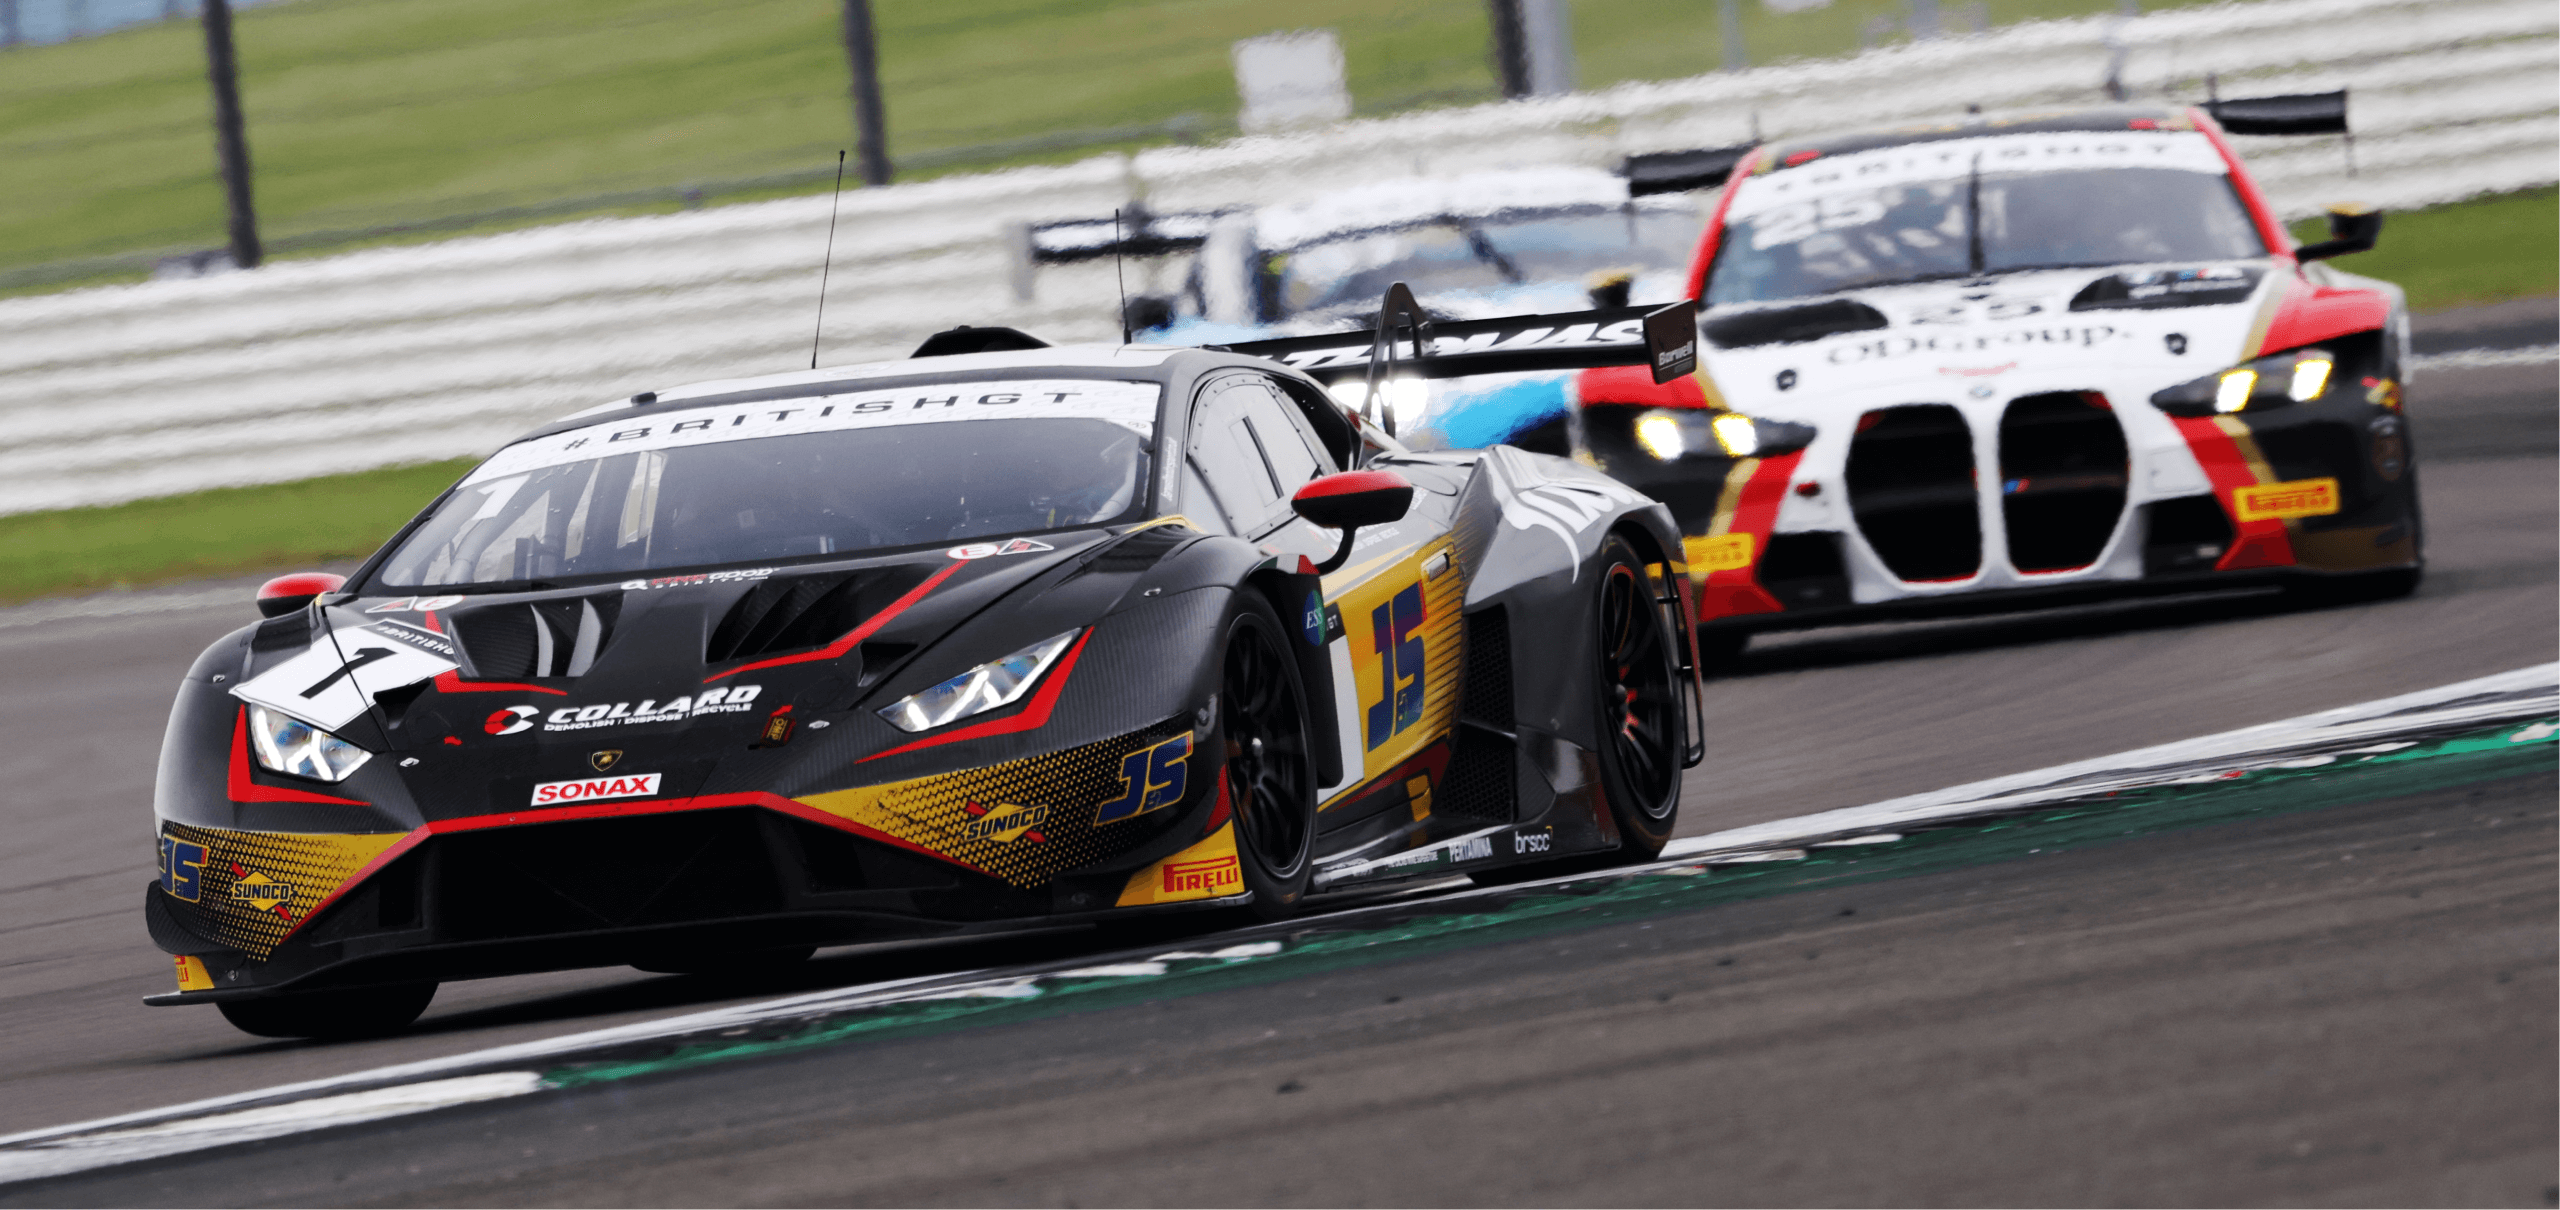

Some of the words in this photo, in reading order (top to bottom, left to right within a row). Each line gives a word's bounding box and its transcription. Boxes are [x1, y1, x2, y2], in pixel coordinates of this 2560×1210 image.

[563, 391, 1091, 451] #BRITISHGT
[376, 625, 456, 655] #BRITISHG
[298, 647, 399, 700] 1
[1366, 579, 1428, 753] JS
[543, 718, 615, 732] DEMOLISH
[624, 713, 683, 725] DISPOSE
[692, 703, 752, 717] RECYCLE
[547, 684, 763, 724] COLLARD
[537, 776, 651, 802] SONAX
[1093, 730, 1193, 828] JS
[967, 804, 1048, 841] SUNOCO
[1449, 837, 1493, 863] PERTAMINA
[1515, 831, 1550, 854] brscc
[159, 834, 210, 903] JS
[1162, 855, 1239, 893] PIRELLI
[232, 883, 290, 900] SUNOCO
